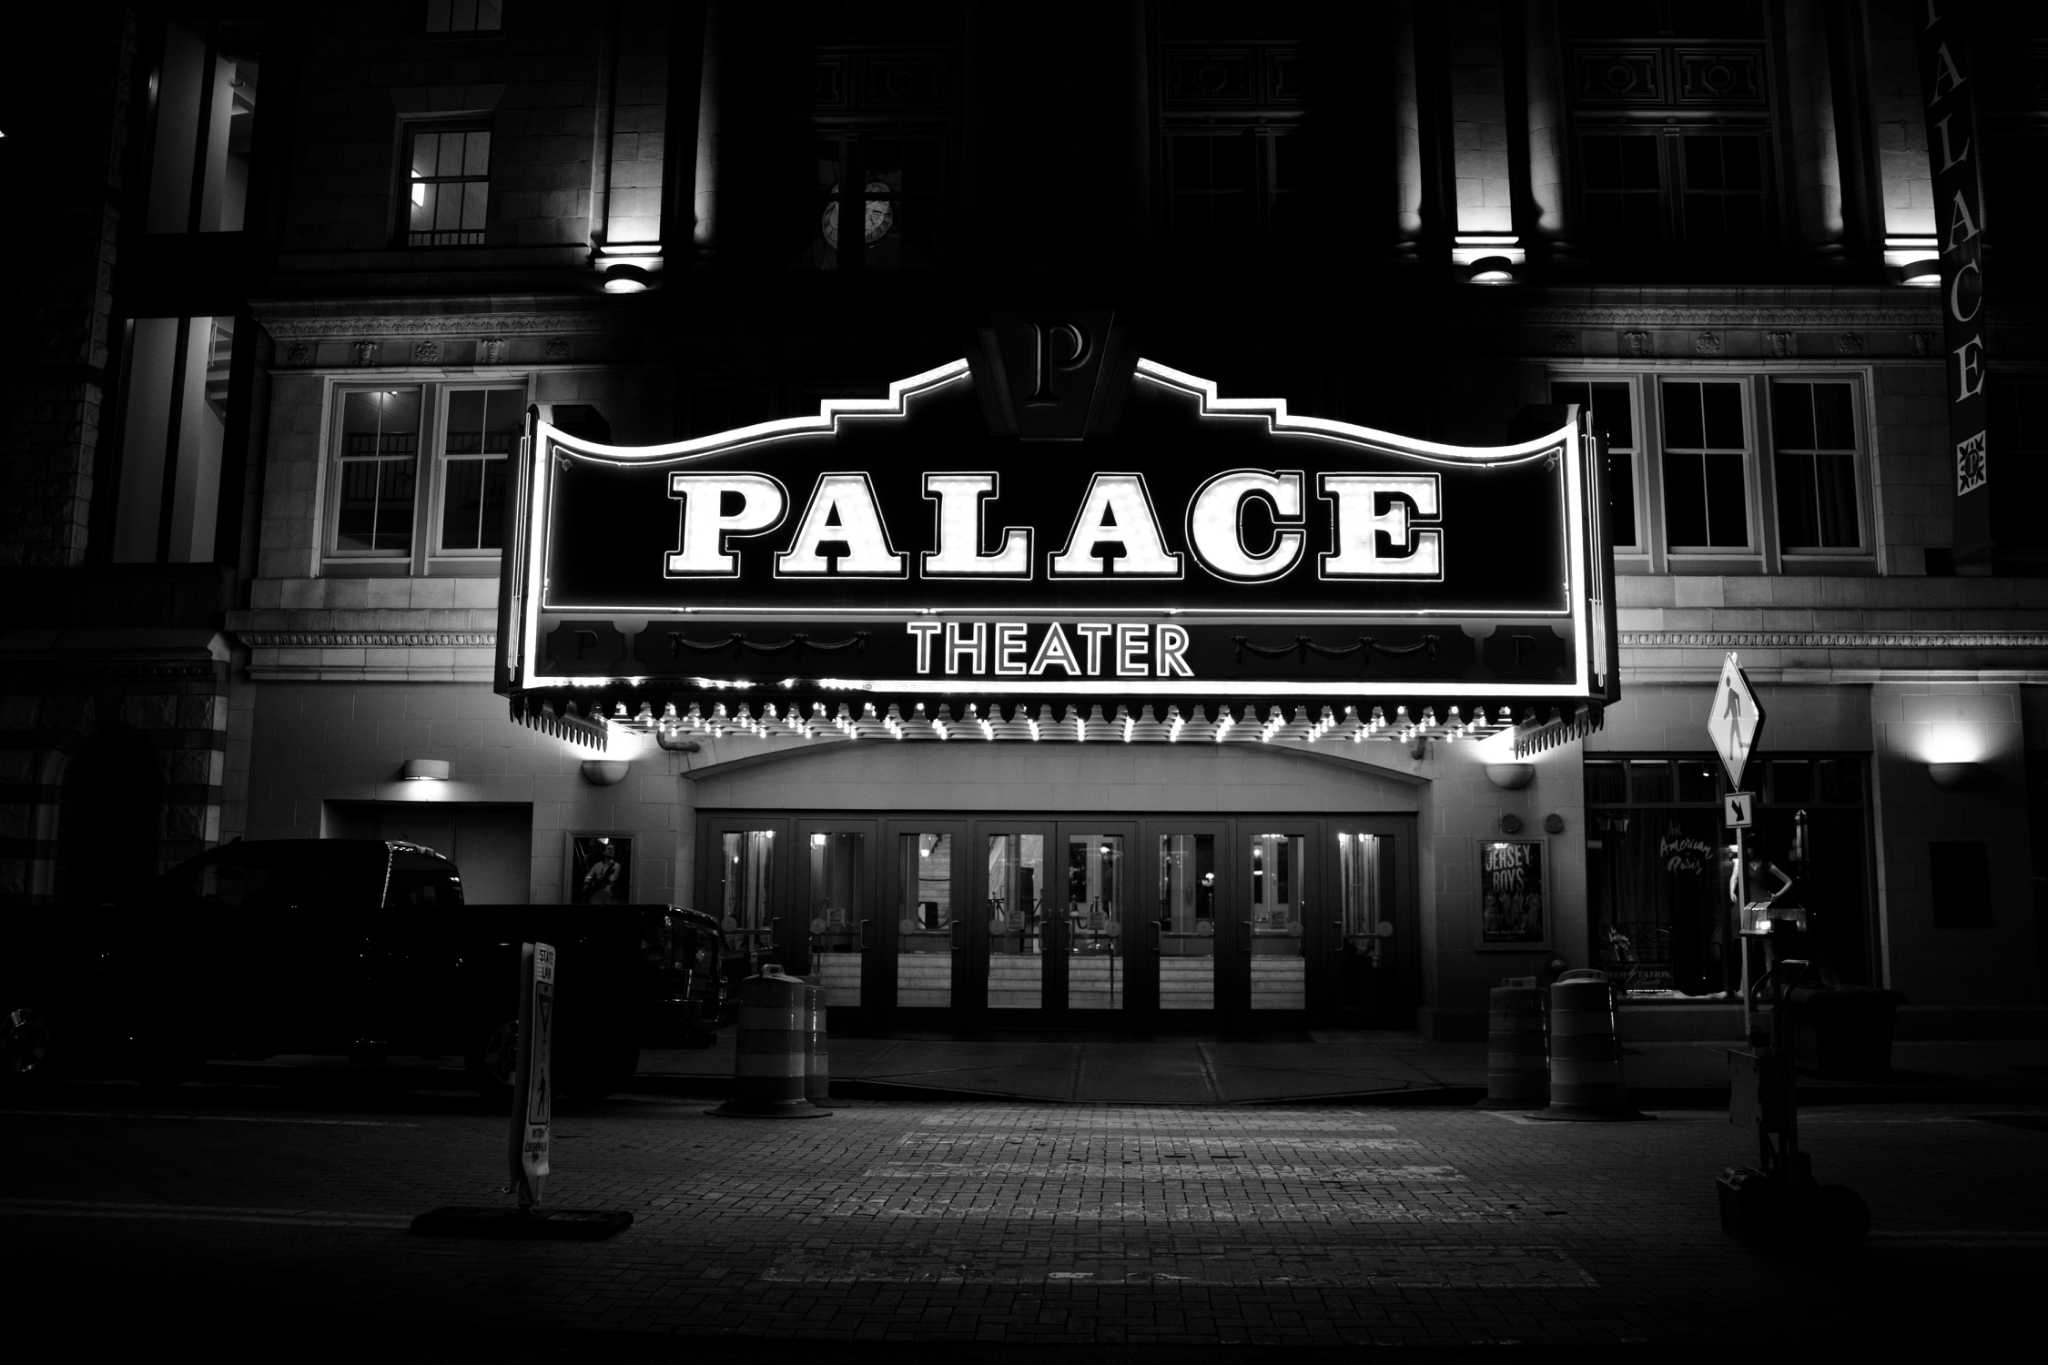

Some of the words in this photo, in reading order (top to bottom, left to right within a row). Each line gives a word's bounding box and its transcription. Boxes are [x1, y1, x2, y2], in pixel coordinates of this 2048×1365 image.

[1024, 320, 1093, 407] P
[663, 468, 1445, 583] PALACE
[906, 622, 1195, 679] THEATER
[1485, 844, 1531, 871] JERSEY
[1492, 867, 1525, 893] BOYS
